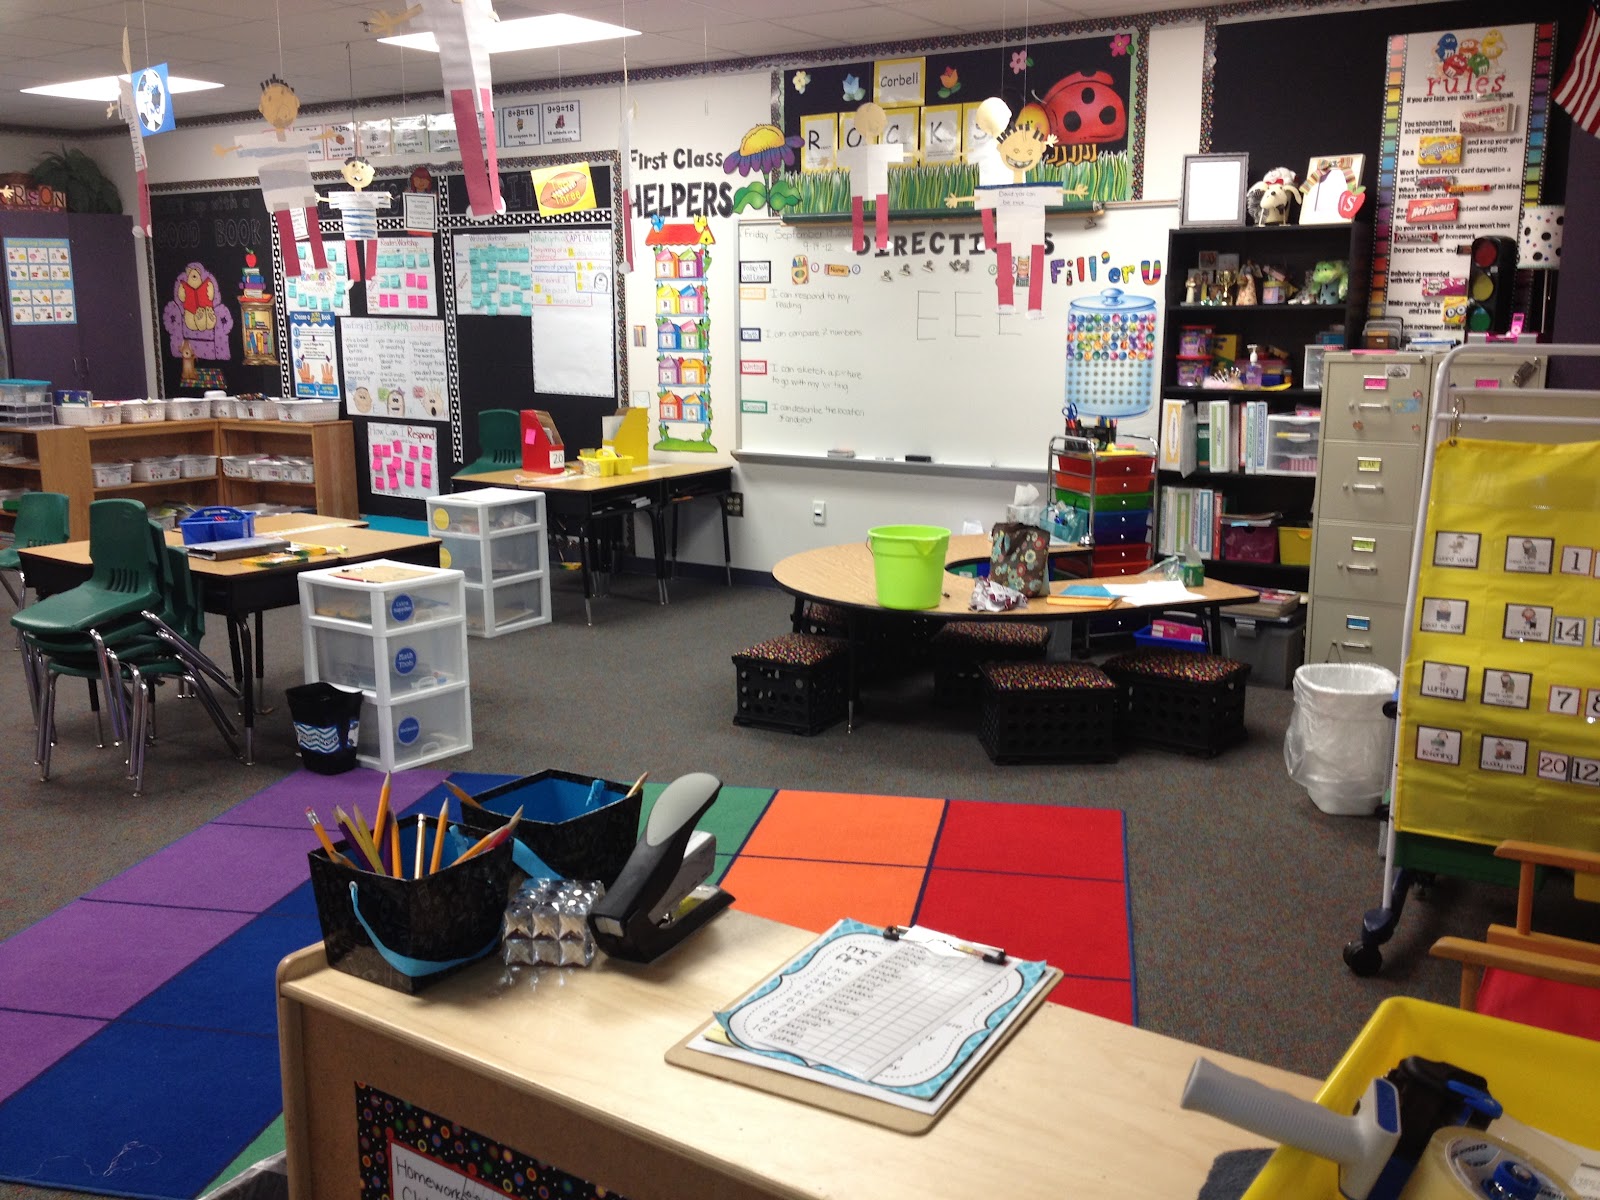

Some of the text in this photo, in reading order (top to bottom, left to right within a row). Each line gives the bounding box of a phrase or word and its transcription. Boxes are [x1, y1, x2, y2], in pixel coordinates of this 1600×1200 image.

[880, 71, 919, 88] Corbell
[1426, 67, 1506, 96] rules
[507, 107, 535, 118] 8+8=16
[547, 103, 575, 114] 9+9=18
[1421, 127, 1434, 135] your
[1480, 138, 1494, 146] keep
[630, 148, 723, 170] First Class
[1399, 168, 1415, 176] Work
[1475, 167, 1486, 175] day
[554, 190, 582, 206] Three
[630, 181, 734, 218] HELPERS
[1343, 195, 1357, 212] S
[1411, 202, 1454, 218] HOT TAMALES
[1499, 204, 1513, 212] your
[156, 219, 200, 248] GOOD
[214, 217, 262, 247] BOOK
[566, 234, 592, 243] CAPITAL
[743, 228, 769, 243] Friday
[398, 240, 419, 248] Workshop
[1401, 247, 1415, 255] your
[556, 261, 575, 271] people
[742, 263, 757, 272] Today
[779, 291, 792, 299] can
[794, 290, 825, 301] respond
[827, 290, 836, 300] to
[836, 292, 850, 304] my
[775, 301, 802, 314] reading
[774, 330, 786, 338] can
[788, 329, 820, 341] compare
[829, 328, 863, 337] numbers
[781, 365, 795, 373] can
[796, 365, 826, 375] sketch
[790, 378, 807, 386] with
[807, 380, 820, 391] my
[791, 404, 823, 414] describe
[825, 405, 836, 414] the
[385, 424, 399, 437] Can
[407, 424, 435, 443] Respond
[553, 453, 564, 464] 20
[1571, 551, 1581, 572] 1
[1555, 620, 1583, 642] 14
[398, 652, 413, 661] Math
[1427, 682, 1459, 697] writing
[1557, 690, 1573, 710] 7
[1540, 757, 1600, 782] 20 12
[395, 1156, 466, 1200] Homework
